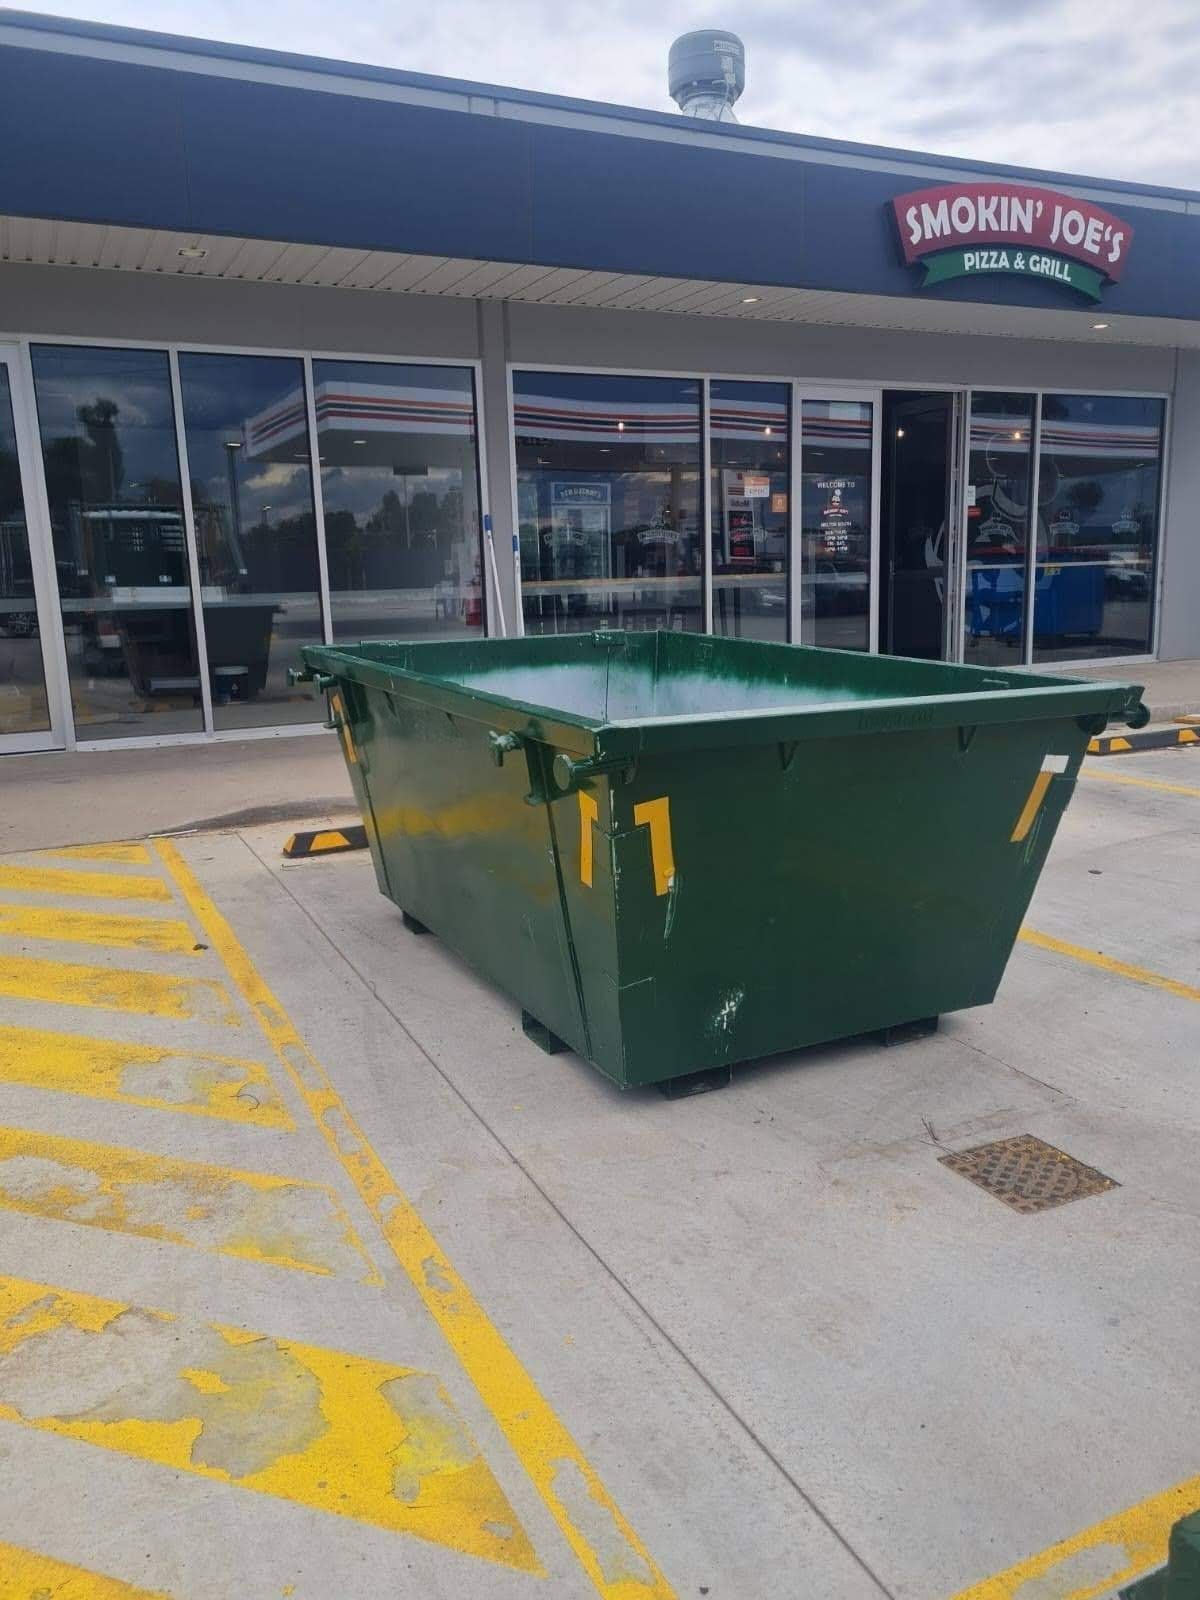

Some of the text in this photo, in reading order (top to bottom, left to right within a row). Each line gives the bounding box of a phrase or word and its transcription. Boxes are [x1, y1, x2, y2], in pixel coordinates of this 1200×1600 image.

[905, 196, 1124, 263] SMOKIN' JOE'S
[963, 251, 1072, 283] PIZZA & GRILL
[817, 481, 846, 489] WELCOME
